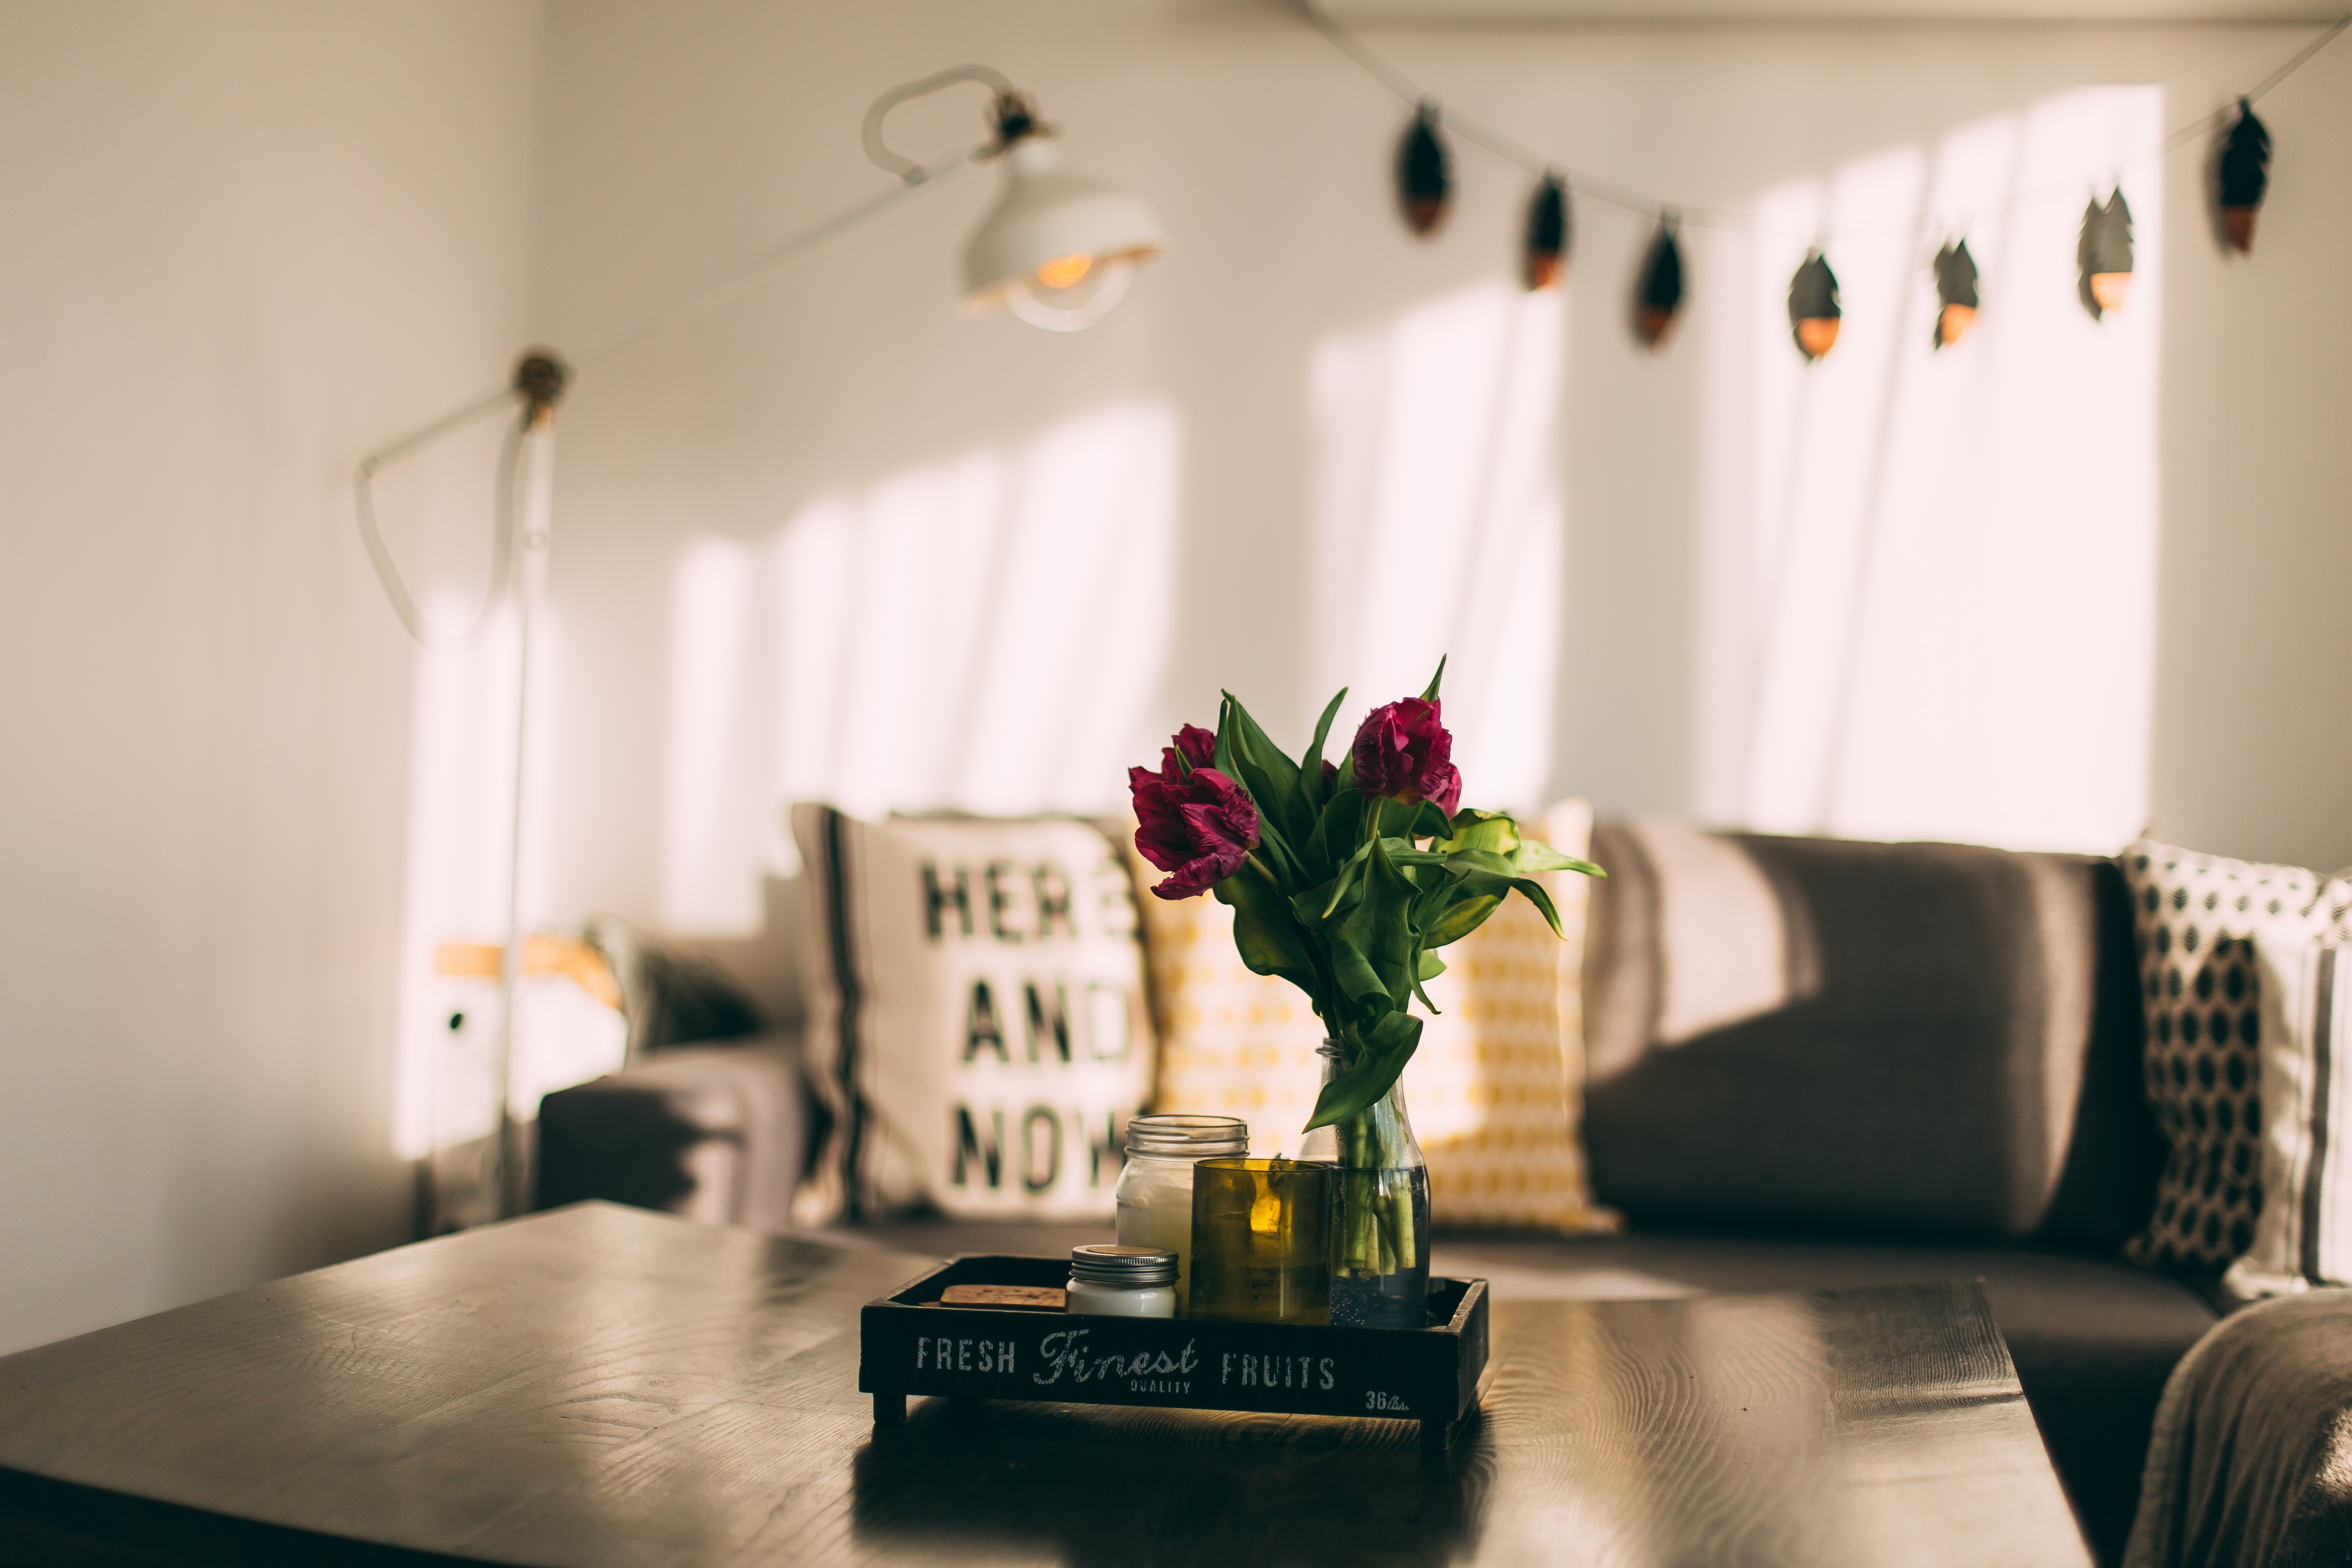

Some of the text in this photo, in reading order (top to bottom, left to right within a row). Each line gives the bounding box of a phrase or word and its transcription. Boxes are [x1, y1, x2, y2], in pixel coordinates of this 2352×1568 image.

[921, 860, 1137, 940] HERE
[963, 980, 1130, 1064] AND
[916, 1329, 1335, 1390] FRESH Finest FRUITS
[1130, 1379, 1191, 1394] QUALITY
